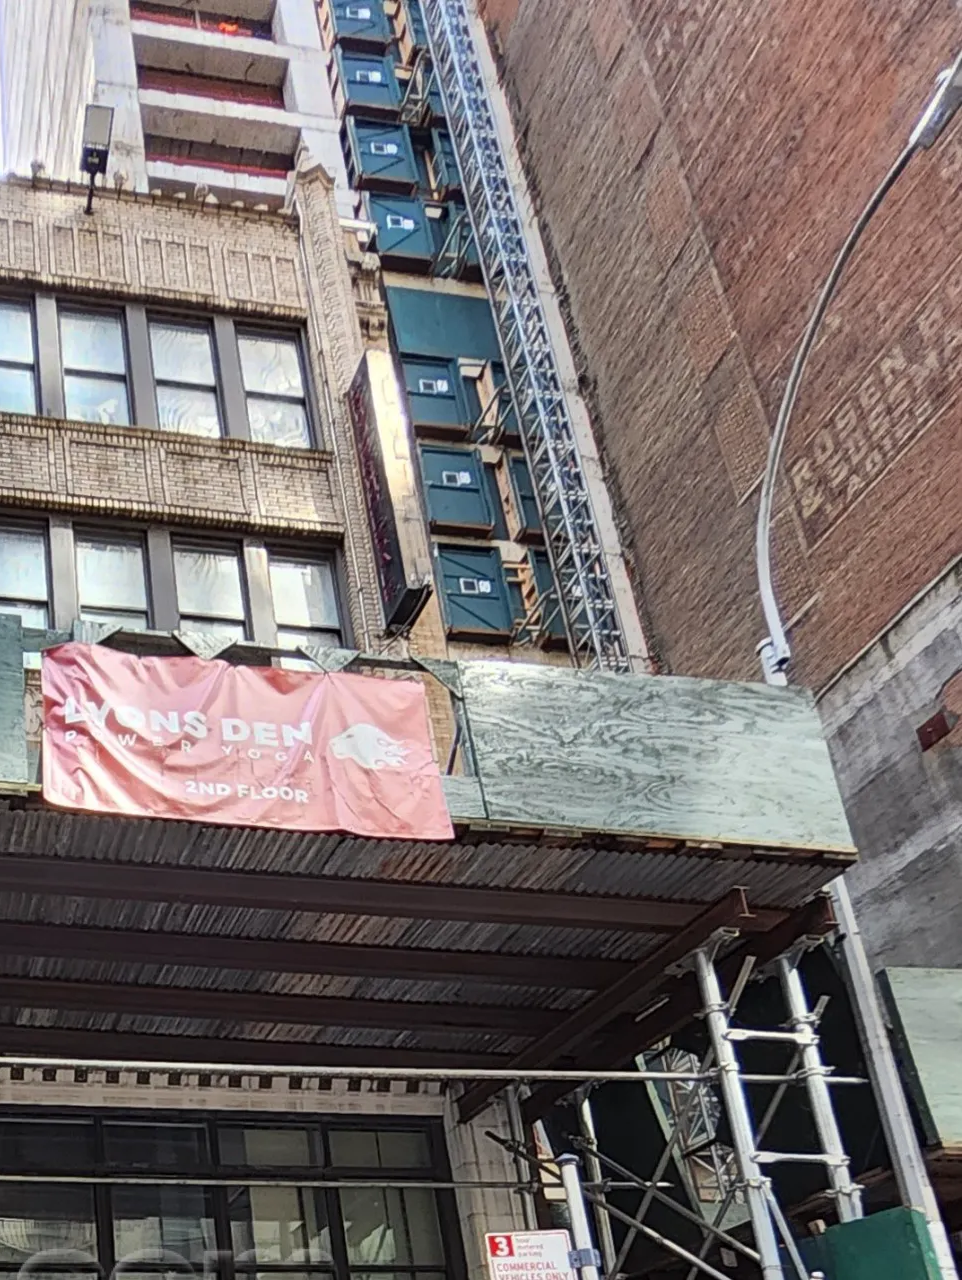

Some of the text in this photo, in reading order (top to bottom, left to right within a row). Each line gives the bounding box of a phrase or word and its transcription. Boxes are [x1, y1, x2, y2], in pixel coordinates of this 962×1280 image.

[64, 696, 312, 748] LYONS DEN
[222, 745, 315, 763] YOGA
[185, 780, 309, 803] 2ND FLOOR
[494, 1236, 510, 1256] 3
[497, 1260, 557, 1272] COMMERCIAL
[545, 1271, 570, 1280] ONLY
